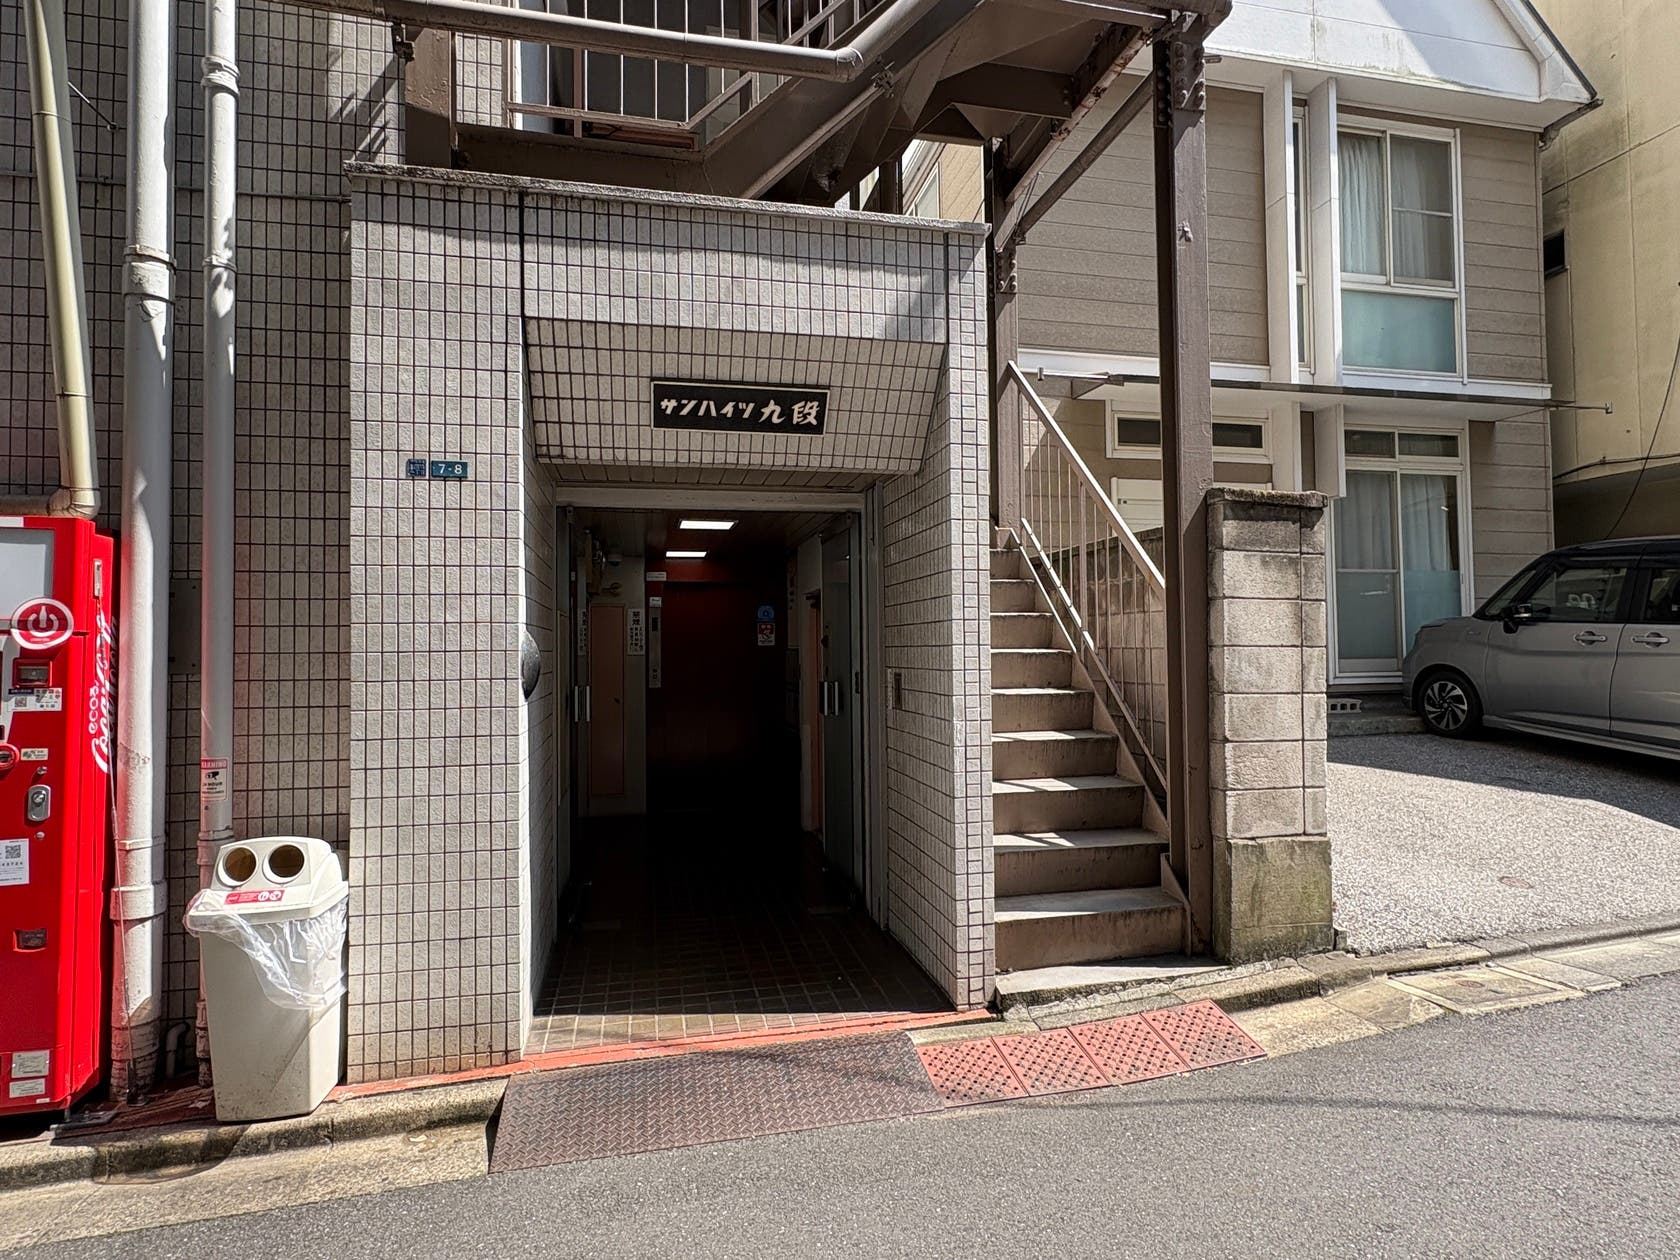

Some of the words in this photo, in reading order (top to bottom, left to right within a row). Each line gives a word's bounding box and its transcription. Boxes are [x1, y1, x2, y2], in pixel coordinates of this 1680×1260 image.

[660, 398, 820, 426] サンハイツ九段
[438, 463, 462, 475] 7-8
